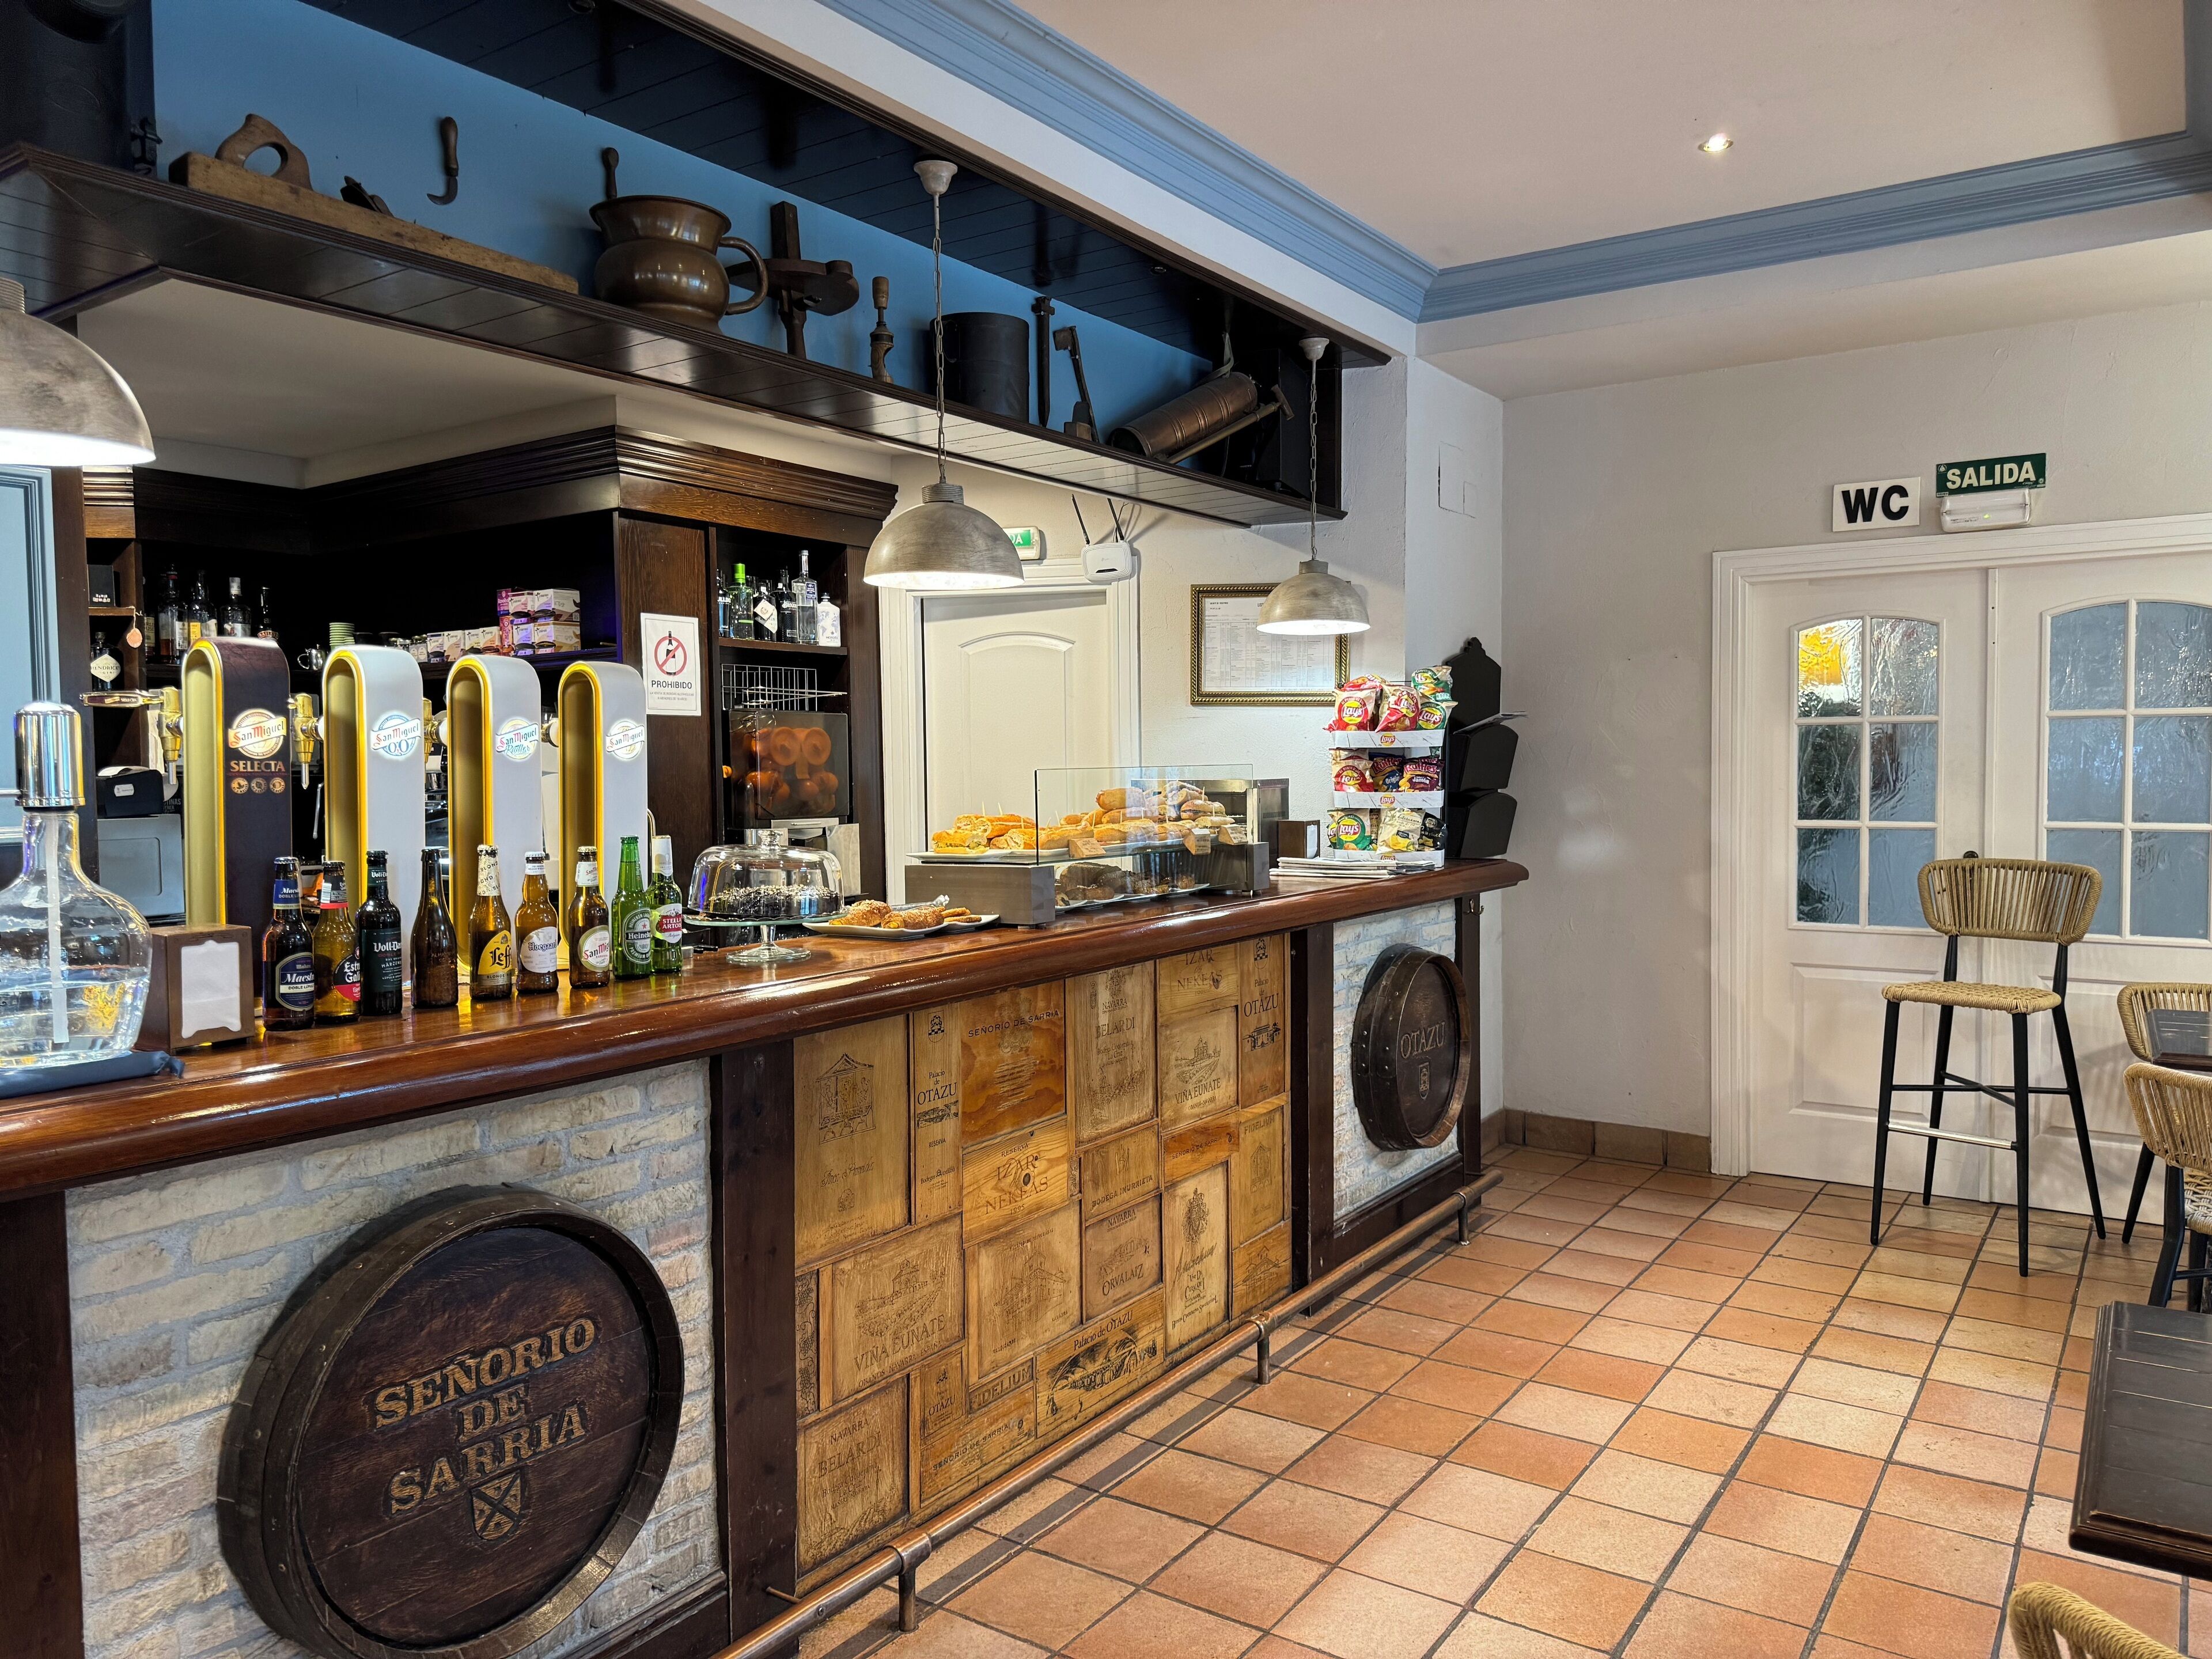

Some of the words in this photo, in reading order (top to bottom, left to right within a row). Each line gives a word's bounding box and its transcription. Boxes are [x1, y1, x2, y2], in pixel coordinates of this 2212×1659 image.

[1946, 461, 2036, 489] SALIDA
[1842, 485, 1909, 524] WC
[652, 680, 692, 689] PROHIBIDO
[230, 731, 252, 747] San
[252, 721, 284, 738] Miguel
[374, 733, 391, 747] San
[392, 722, 419, 738] Miguel
[497, 737, 513, 748] San
[514, 727, 536, 743] Miguel
[607, 738, 622, 749] San
[623, 729, 643, 743] Miguel
[230, 761, 286, 772] SELECTA
[1339, 823, 1359, 835] Lay's
[489, 944, 512, 969] Leff
[1255, 978, 1268, 987] Palacio
[1102, 998, 1127, 1010] NAVARRA
[1244, 993, 1279, 1017] OTAZU
[1014, 1018, 1025, 1027] DE
[1096, 1017, 1135, 1039] BELARDI
[1401, 1022, 1445, 1059] OTAZU
[929, 1070, 945, 1079] Palacio
[917, 1082, 957, 1105] OTAZU
[1175, 1089, 1192, 1104] VIÑA
[1194, 1078, 1221, 1098] EUNATE
[1244, 1115, 1275, 1135] FIDELIUM
[929, 1138, 946, 1148] RESERVA
[1001, 1143, 1029, 1157] RESERVA
[986, 1176, 1048, 1214] NEKEAS
[1092, 1190, 1118, 1209] BODEGA
[1010, 1203, 1025, 1215] 1995
[1108, 1209, 1135, 1228] NAVARRA
[1074, 1331, 1096, 1351] Palacio
[1097, 1326, 1105, 1338] de
[1107, 1309, 1133, 1332] OTAZU
[854, 1343, 889, 1372] VIÑA
[893, 1314, 945, 1354] EUNATE
[374, 1318, 595, 1430] SEÑORIO
[459, 1383, 525, 1442] DE
[929, 1395, 956, 1416] OTAZU
[830, 1418, 869, 1445] NAVARRA
[982, 1424, 1008, 1442] SARRIA
[390, 1404, 585, 1514] SARRIA
[818, 1431, 881, 1479] BELARDI
